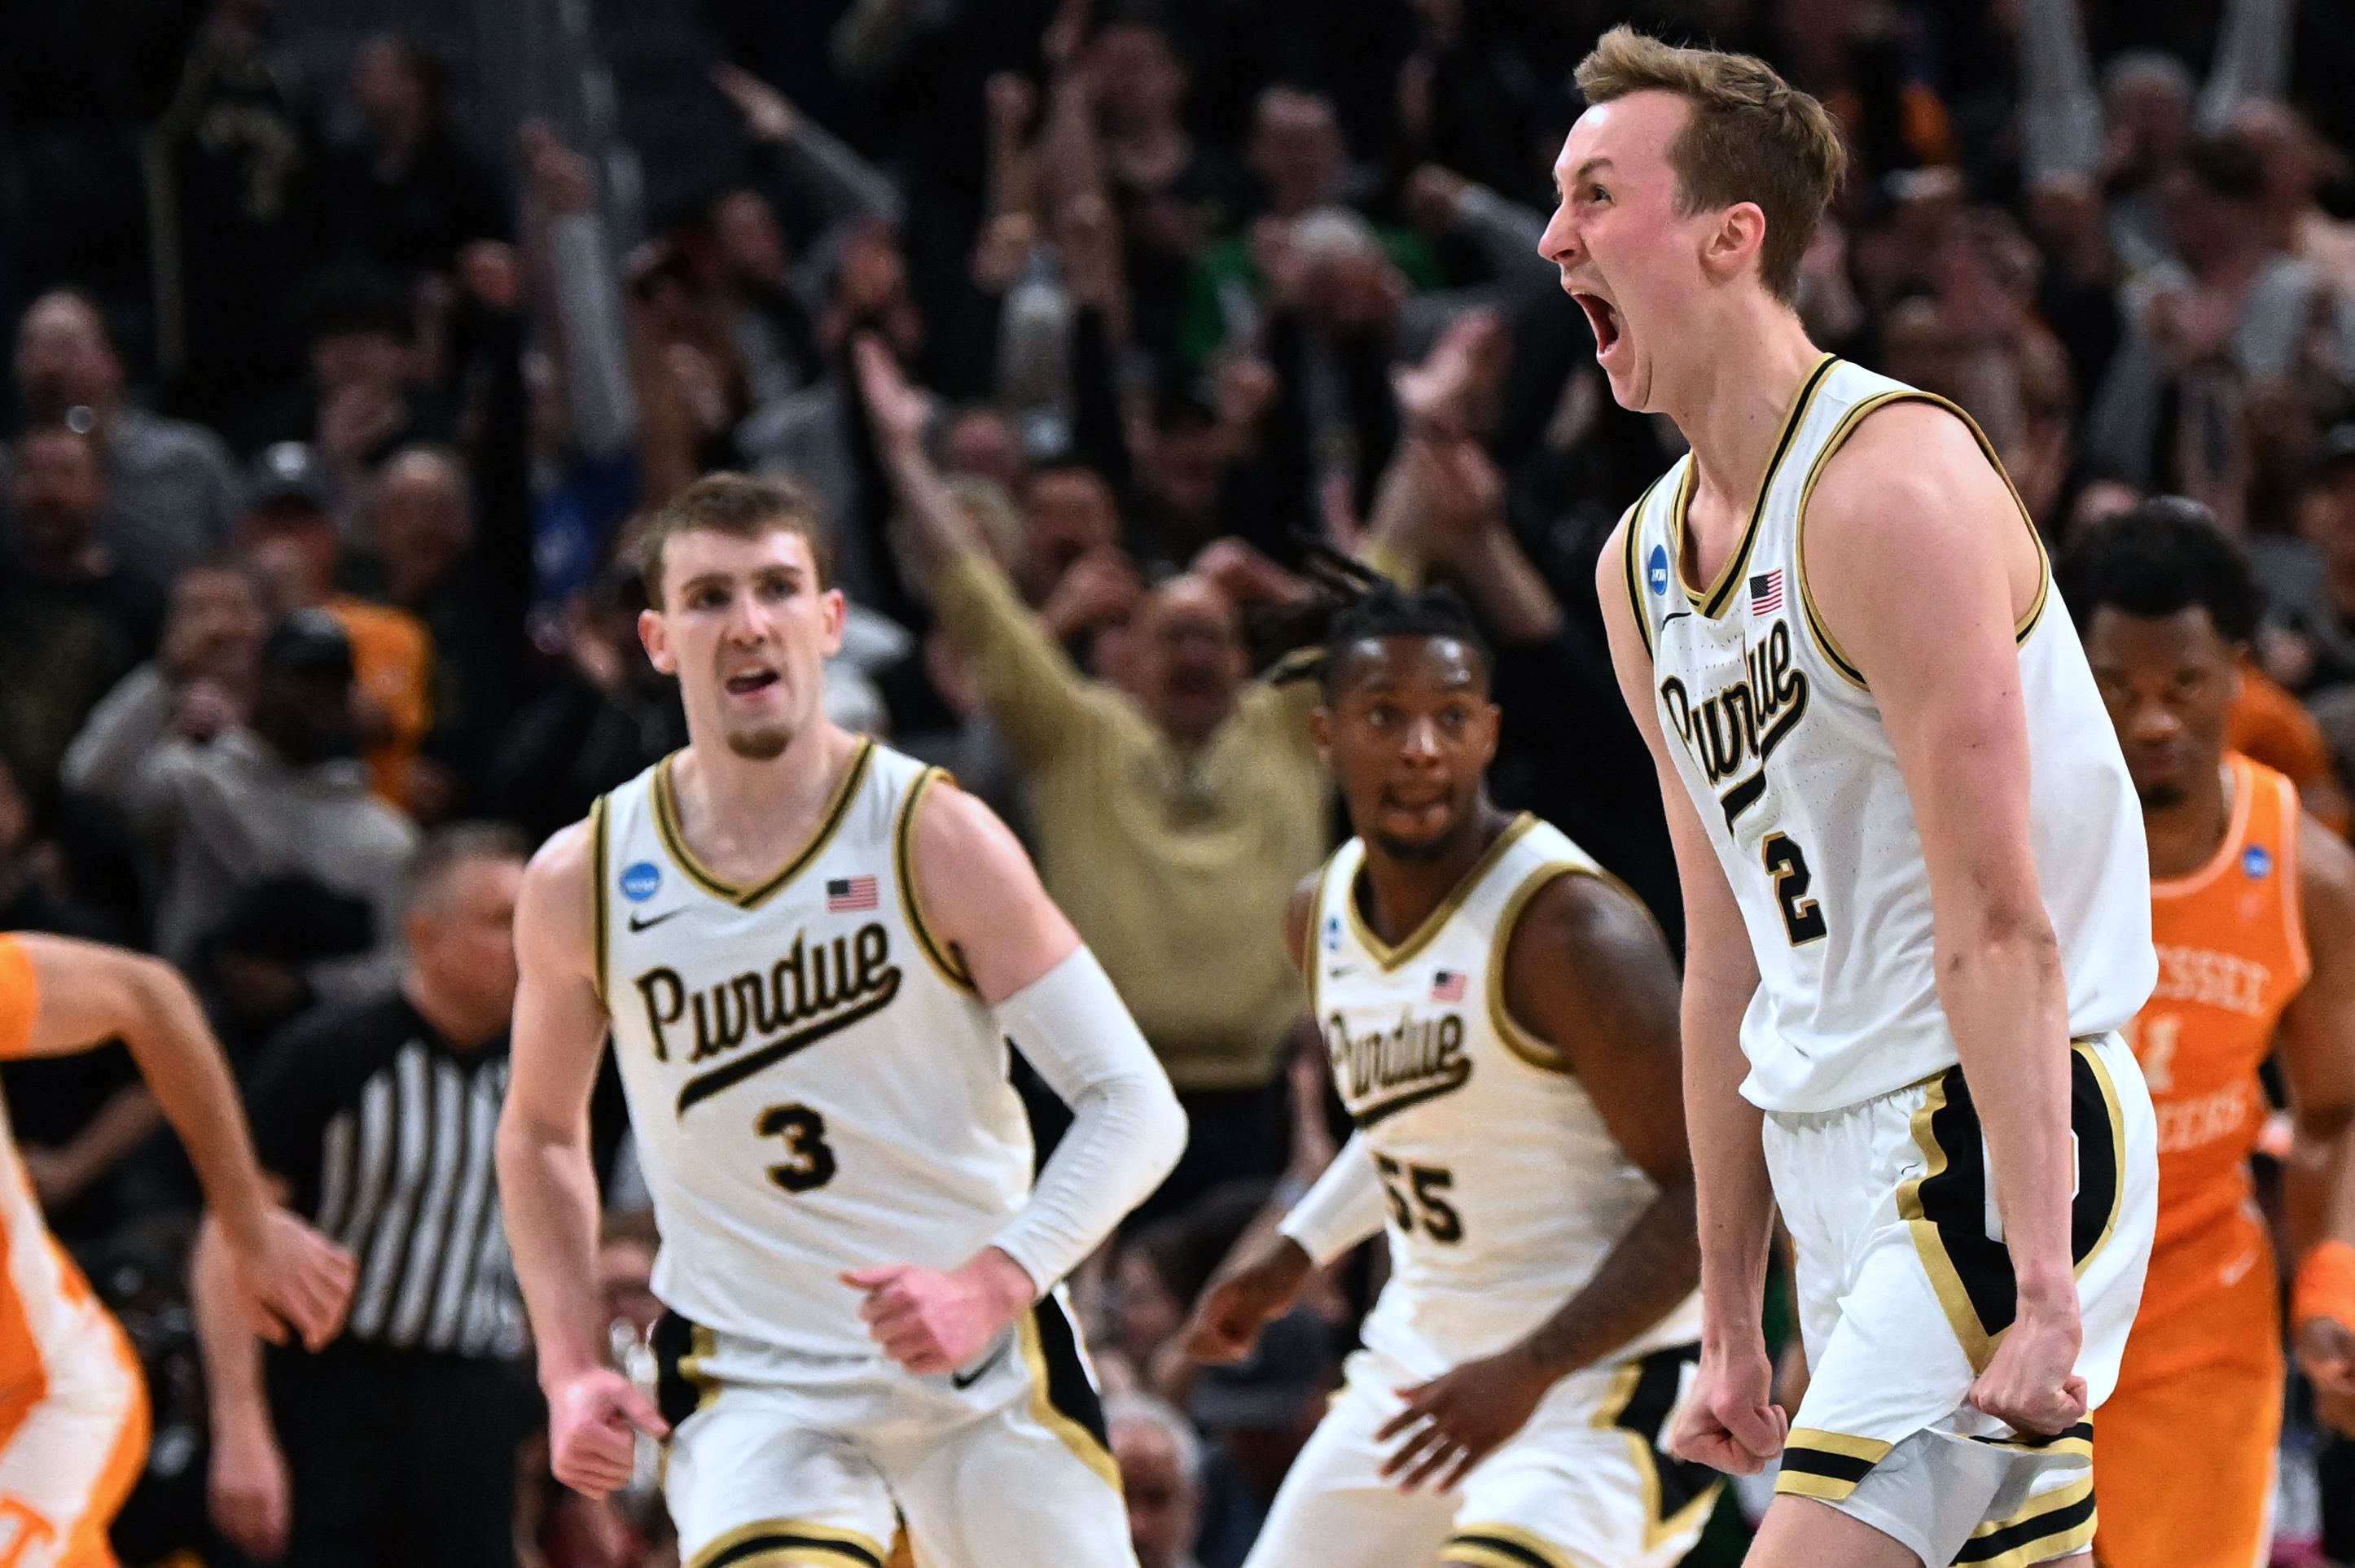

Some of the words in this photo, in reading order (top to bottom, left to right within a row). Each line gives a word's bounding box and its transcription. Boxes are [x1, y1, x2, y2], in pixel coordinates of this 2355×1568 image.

[1660, 619, 1809, 786] Purue
[1761, 830, 1827, 947] 2
[635, 922, 901, 1062] Purdue
[756, 1103, 838, 1194] 3
[1371, 1151, 1464, 1242] 55
